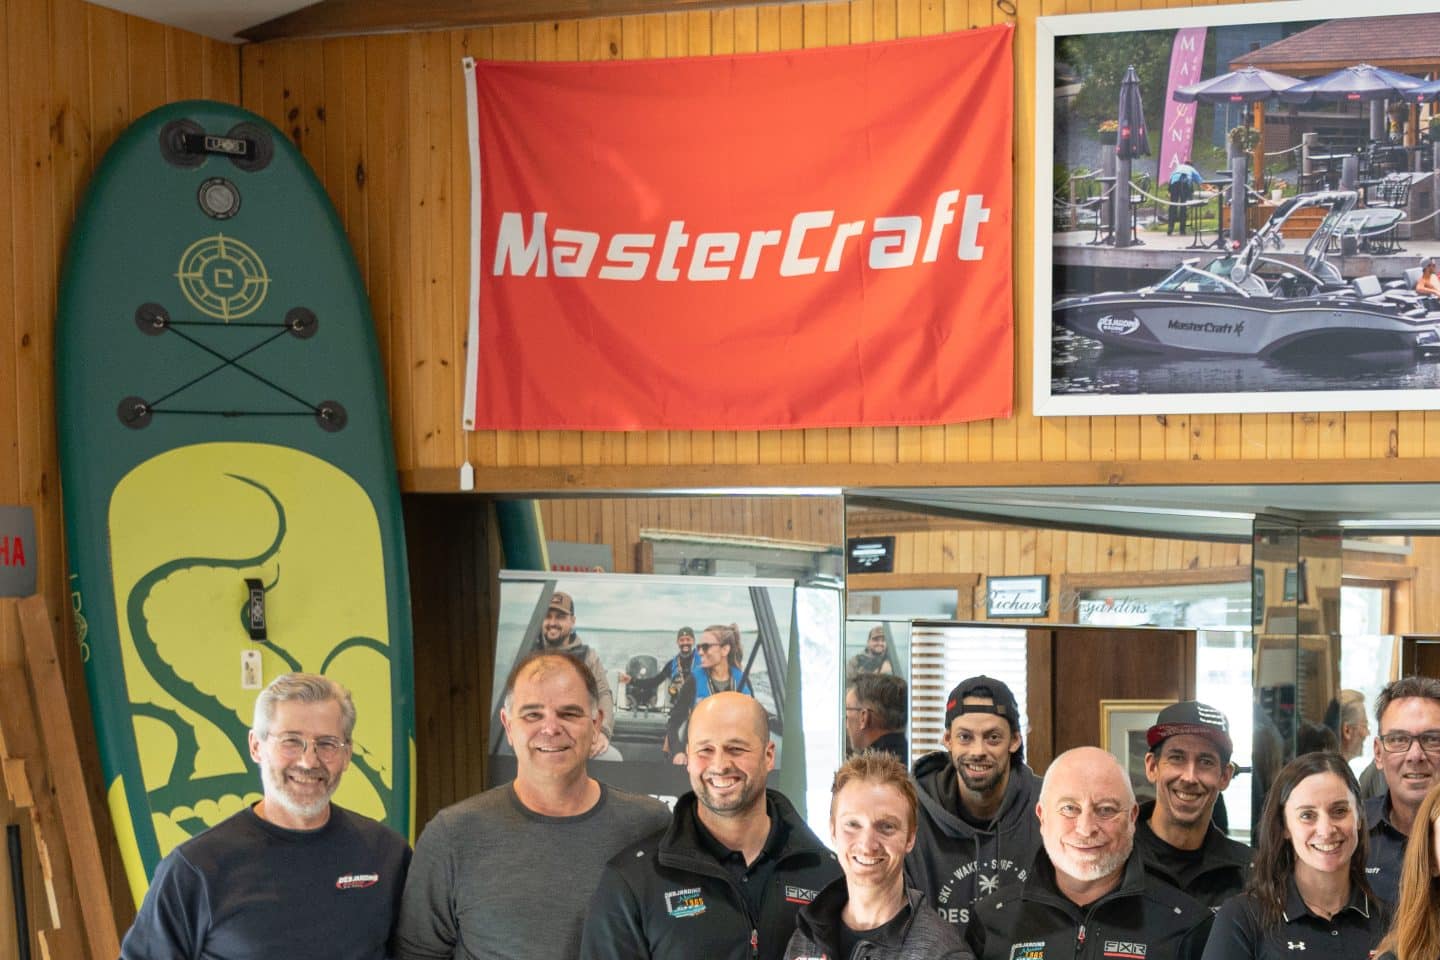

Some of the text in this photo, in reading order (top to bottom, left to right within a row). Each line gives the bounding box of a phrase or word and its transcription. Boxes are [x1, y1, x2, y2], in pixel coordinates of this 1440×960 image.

[493, 189, 991, 282] MasterCraft
[1168, 319, 1233, 334] MasterCraft
[939, 884, 953, 904] SKI
[1103, 940, 1147, 956] FXR
